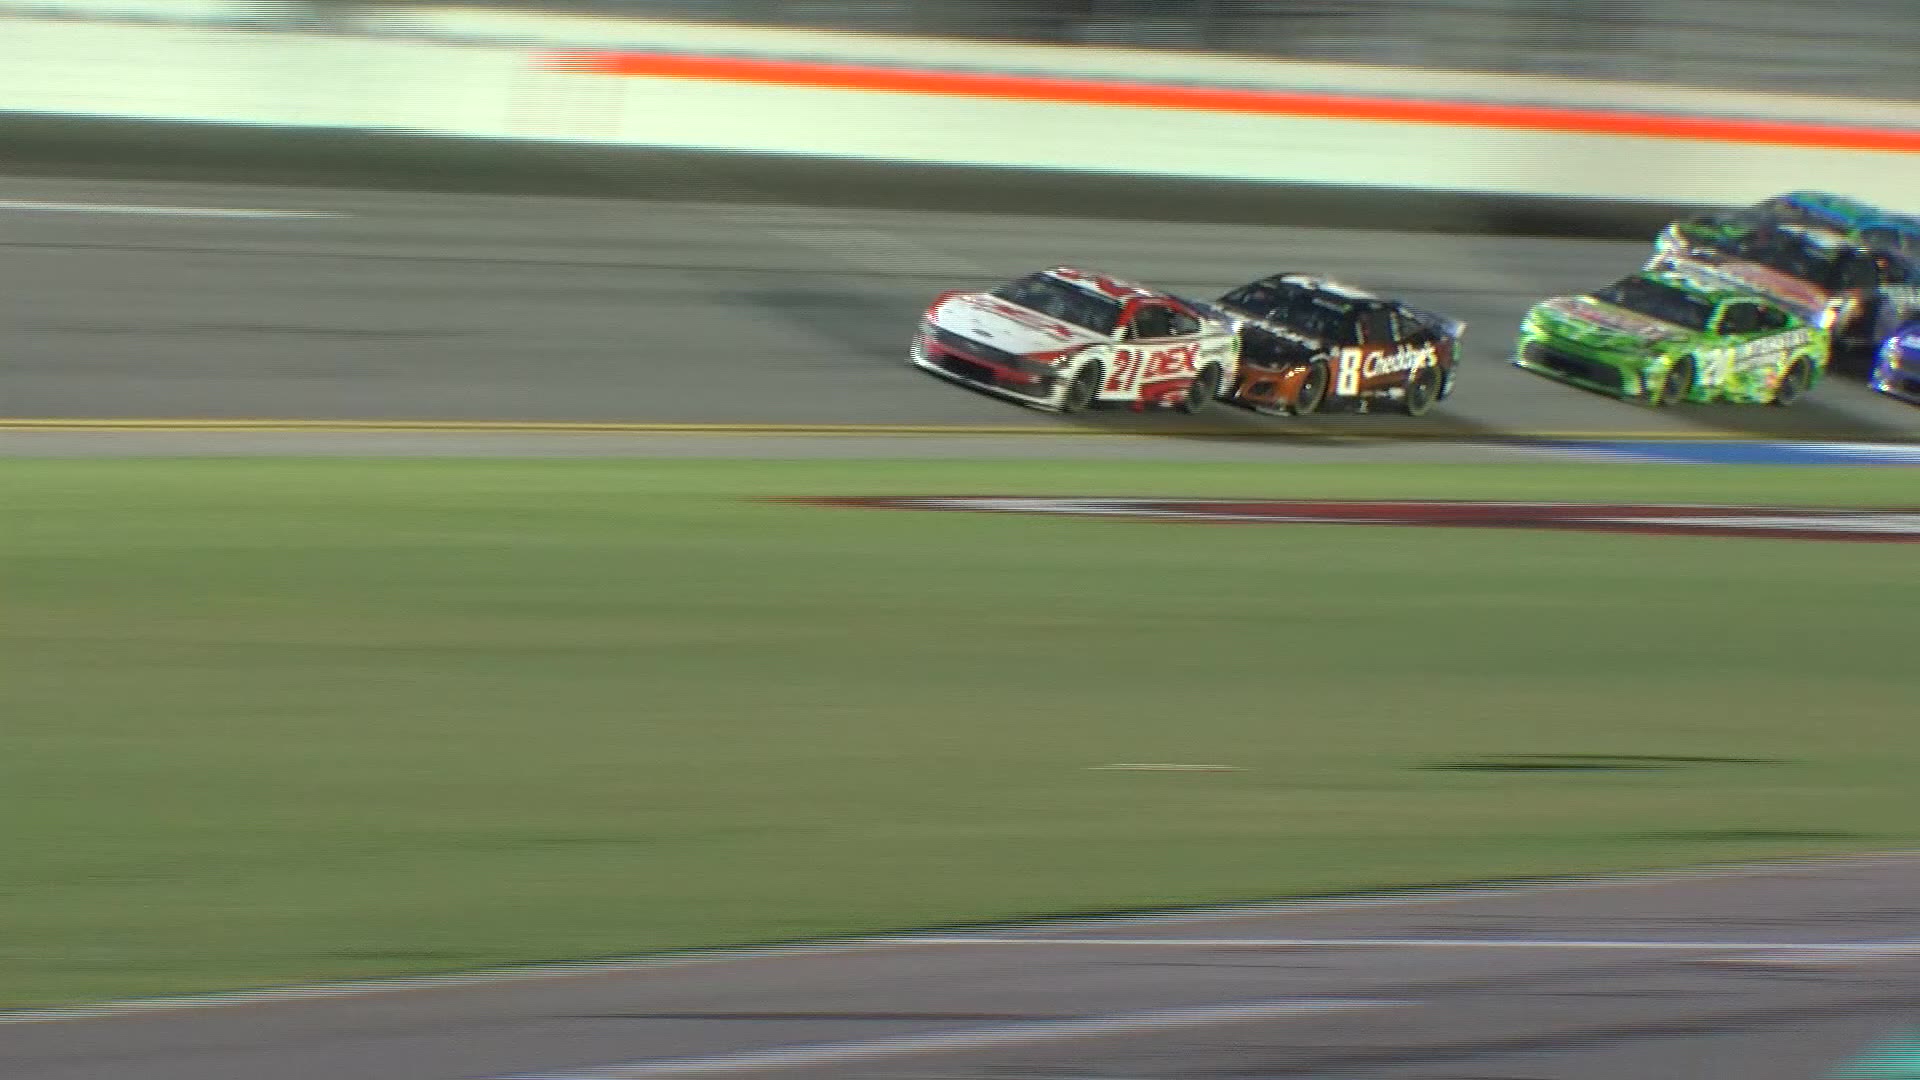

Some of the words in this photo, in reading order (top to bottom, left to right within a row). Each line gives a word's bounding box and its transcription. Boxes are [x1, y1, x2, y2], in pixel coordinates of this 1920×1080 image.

[1103, 349, 1141, 392] 21
[1141, 343, 1201, 379] DEX
[1337, 346, 1362, 396] 8
